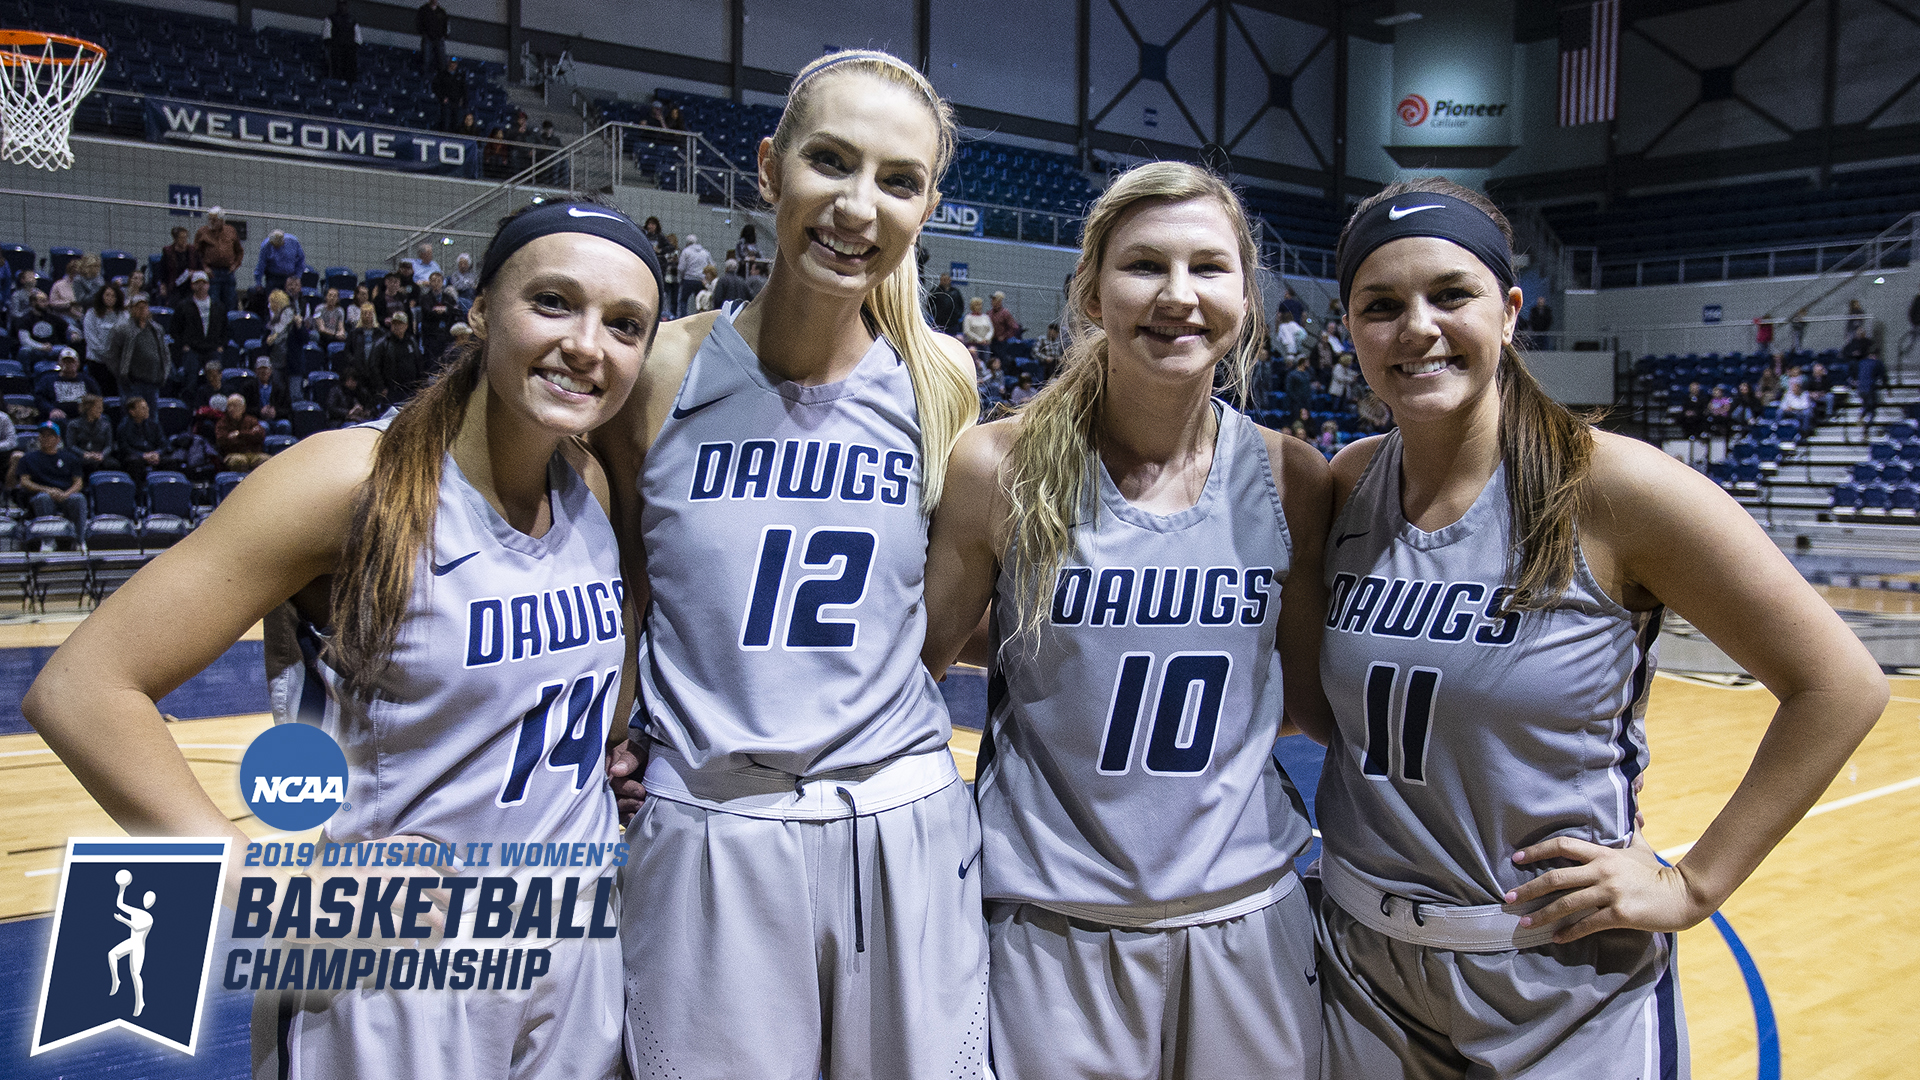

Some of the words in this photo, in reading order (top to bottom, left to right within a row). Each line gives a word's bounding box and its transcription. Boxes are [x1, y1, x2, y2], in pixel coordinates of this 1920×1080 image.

[162, 105, 396, 158] WELCOME
[412, 137, 466, 165] TO
[1433, 100, 1507, 117] Pioneer
[173, 192, 199, 209] 111
[932, 205, 979, 226] UND
[688, 438, 914, 507] DAWGS
[738, 524, 880, 652] 12
[1050, 566, 1275, 628] DAWGS
[1325, 571, 1523, 648] DAWGS
[495, 665, 619, 808] 14
[1096, 650, 1234, 778] 10
[1360, 660, 1443, 787] 11
